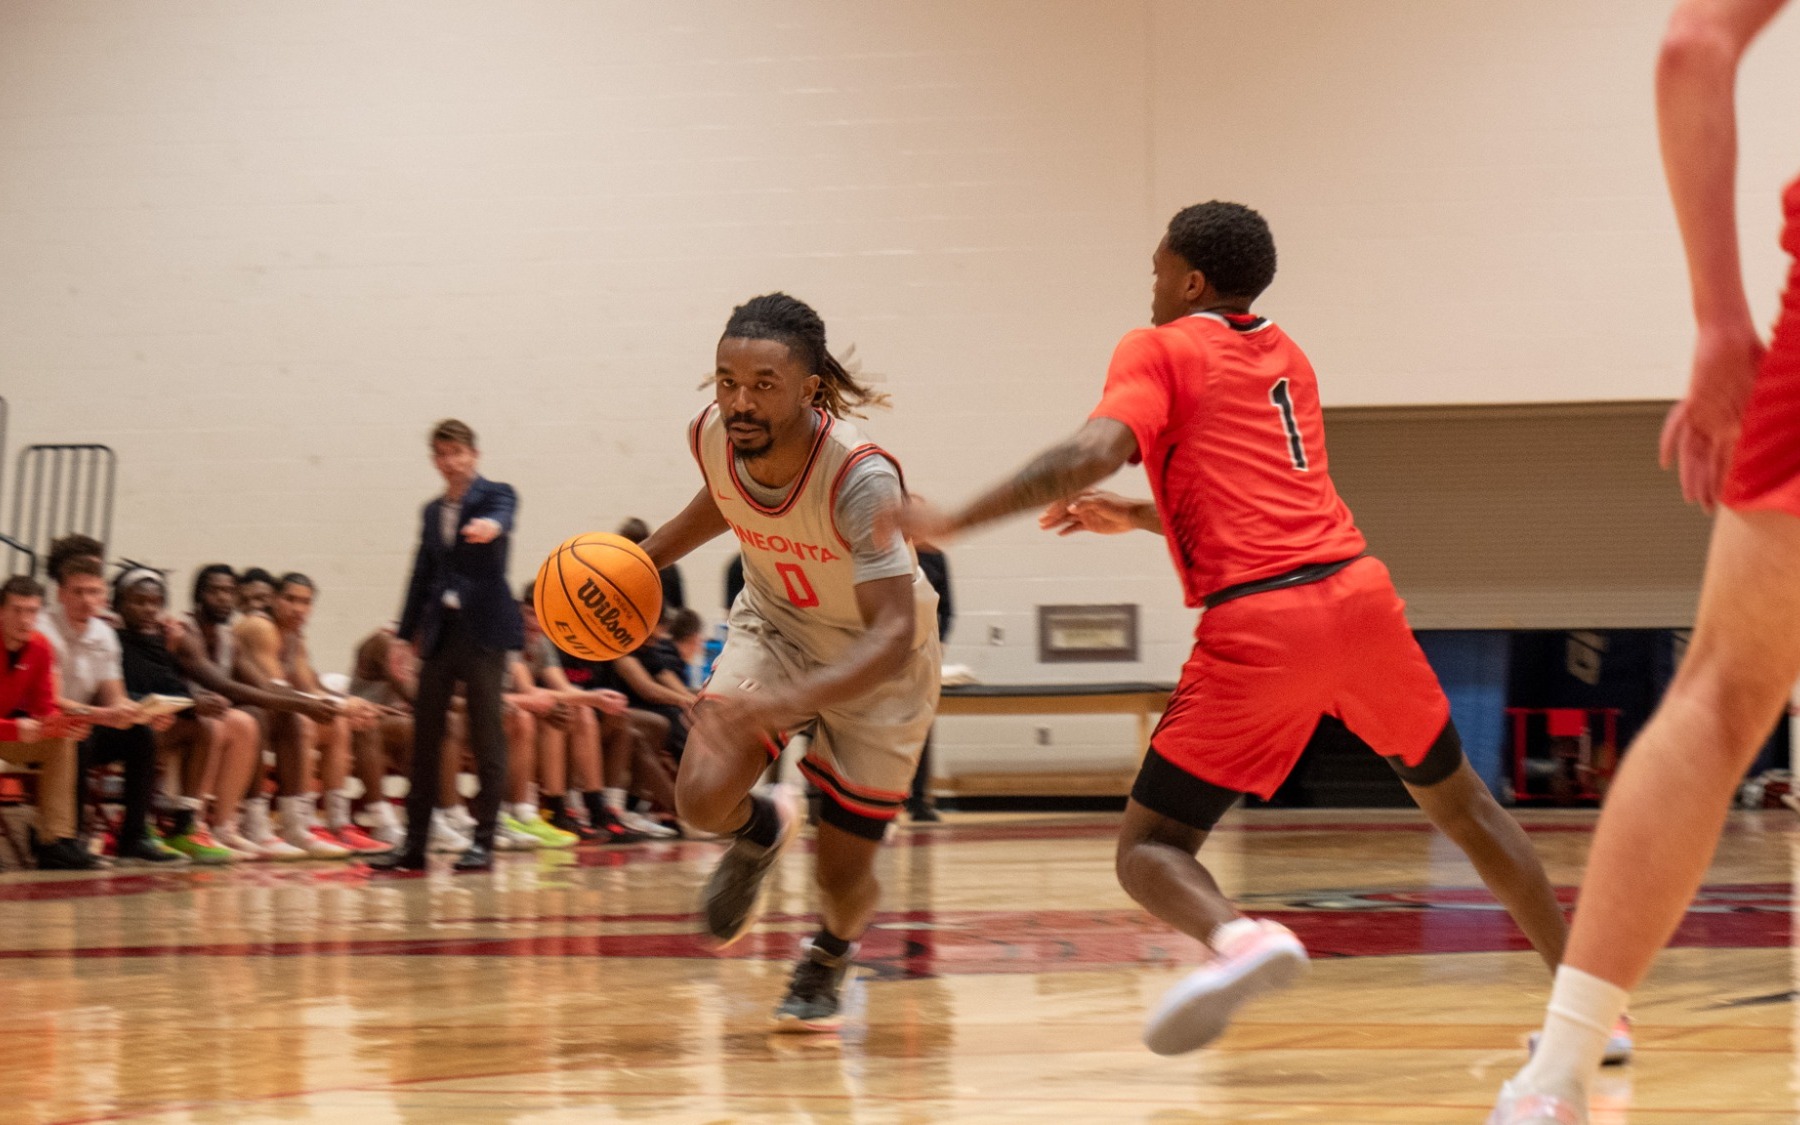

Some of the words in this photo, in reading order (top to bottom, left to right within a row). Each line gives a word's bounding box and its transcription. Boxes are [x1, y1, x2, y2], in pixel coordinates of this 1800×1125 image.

[1268, 377, 1309, 472] 1
[577, 577, 635, 648] Wilson
[775, 562, 820, 608] 0
